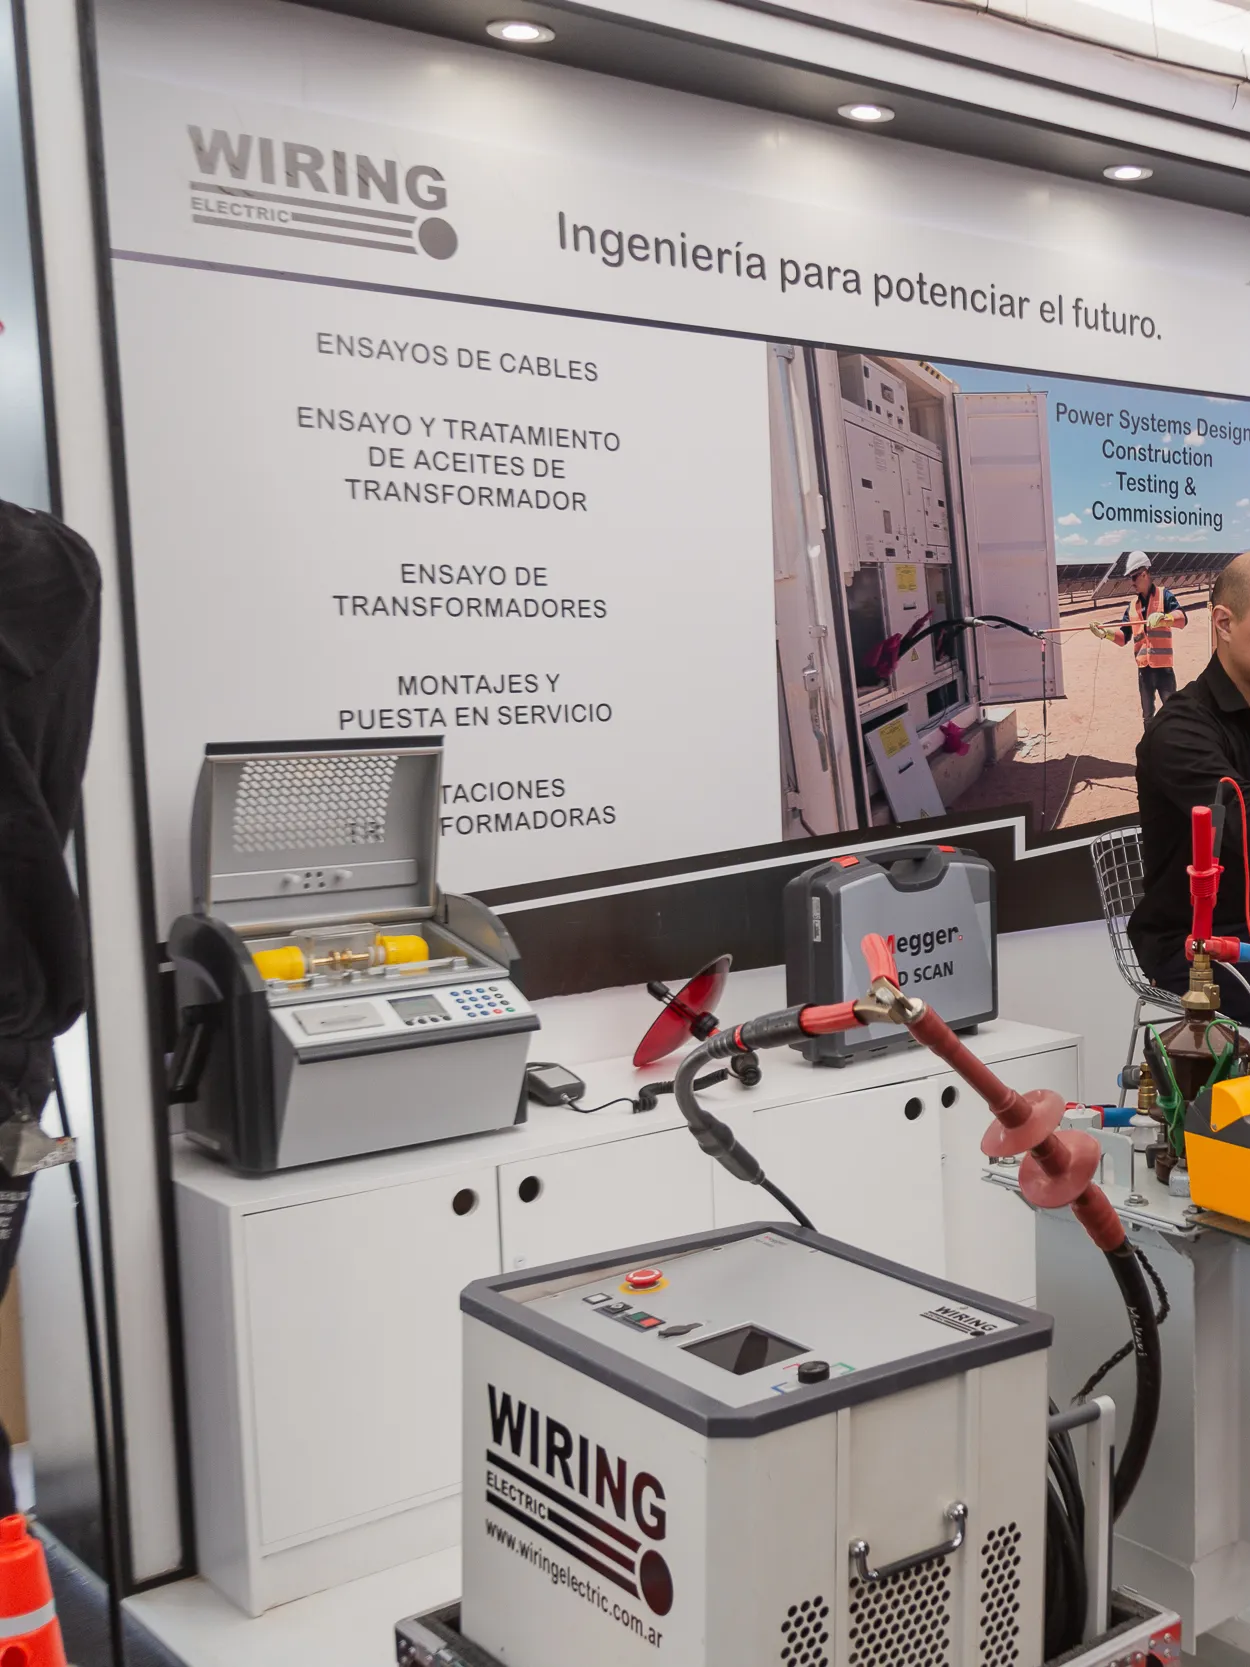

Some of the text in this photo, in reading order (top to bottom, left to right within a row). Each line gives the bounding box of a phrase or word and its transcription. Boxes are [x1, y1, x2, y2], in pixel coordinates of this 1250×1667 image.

[187, 124, 448, 211] WIRING
[191, 197, 291, 223] ELECTRIC
[558, 211, 1163, 340] Ingeniería para potenciar el futuro.
[316, 332, 598, 382] ENSAYOS DE CABLES
[297, 406, 621, 452] ENSAYO Y TRATAMIENTO
[1056, 402, 1114, 428] Power
[1119, 409, 1192, 435] Systems
[368, 446, 565, 479] DE ACEITES DE
[1102, 439, 1213, 467] Construction
[345, 478, 587, 512] TRANSFORMADOR
[1116, 471, 1197, 499] Testing &
[1092, 500, 1223, 532] Commissioning
[401, 563, 548, 587] ENSAYO DE
[333, 595, 607, 619] TRANSFORMADORES
[397, 673, 560, 696] MONTAJES Y
[339, 702, 613, 730] PUESTA EN SERVICIO
[914, 960, 954, 984] SCAN
[935, 1305, 998, 1331] WIRING
[487, 1383, 667, 1541] WIRING
[486, 1470, 547, 1520] ELECTRIC
[485, 1518, 664, 1648] www.wiringelectric.com.ar
